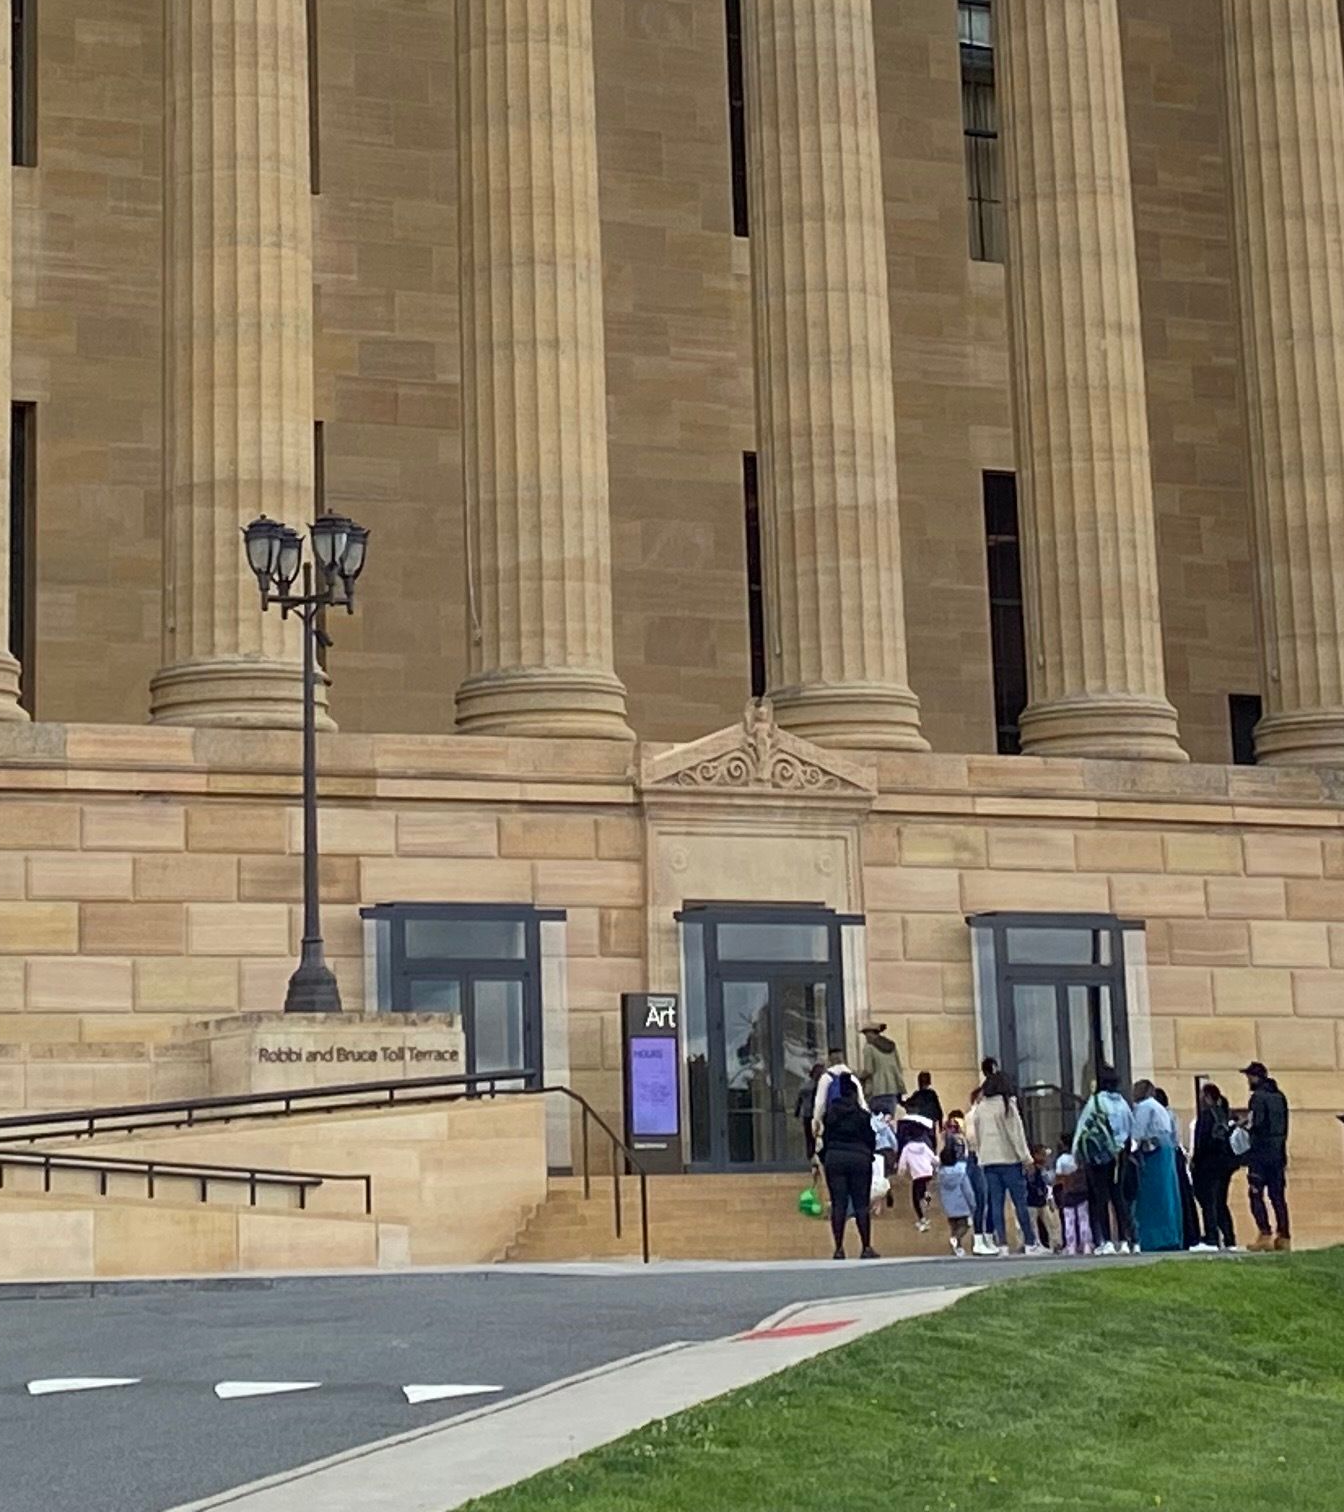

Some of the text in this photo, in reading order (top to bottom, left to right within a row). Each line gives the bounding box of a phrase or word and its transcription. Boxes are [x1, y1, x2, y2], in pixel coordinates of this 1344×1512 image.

[645, 1004, 676, 1028] Art
[258, 1045, 459, 1063] Robbi and Bruce Toll Terrace
